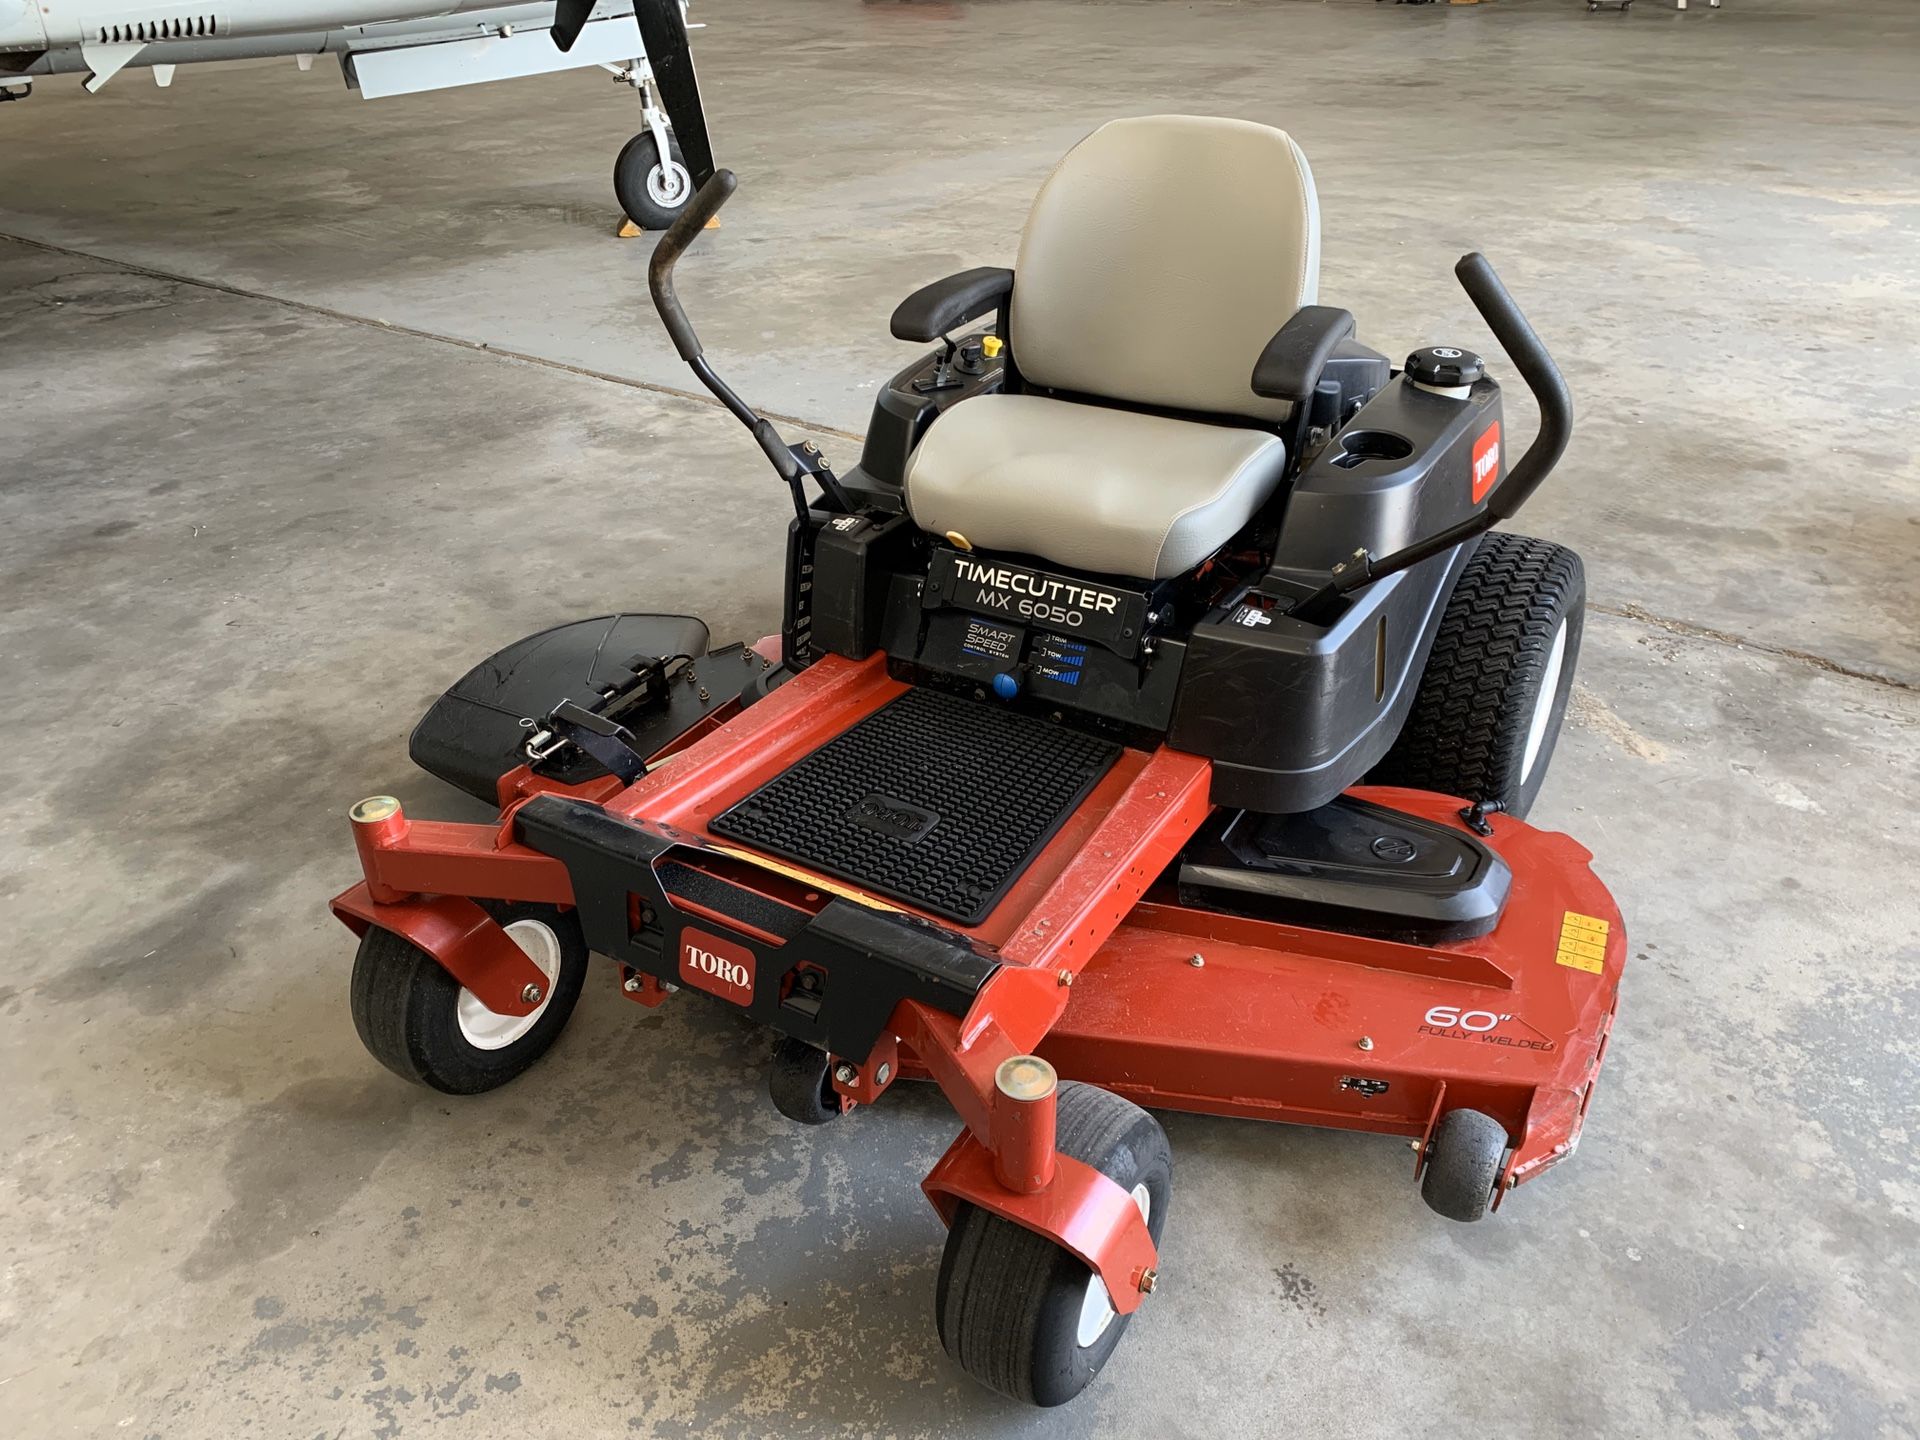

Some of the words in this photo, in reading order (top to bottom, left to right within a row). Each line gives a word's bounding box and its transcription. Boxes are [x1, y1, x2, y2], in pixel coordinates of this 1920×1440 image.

[1475, 442, 1499, 484] TORO
[954, 559, 1120, 614] TIMECUTTER
[976, 589, 1011, 610] MX
[1018, 601, 1083, 627] 6050
[964, 634, 1008, 651] SPEED
[968, 624, 1015, 642] SMART
[963, 643, 987, 653] CONTROL
[988, 650, 1010, 659] SYSTEM
[1042, 667, 1060, 676] MOW
[685, 945, 748, 987] TORO
[1424, 1006, 1511, 1032] 60"
[1417, 1026, 1471, 1040] FULLY
[1482, 1034, 1554, 1051] WELDED
